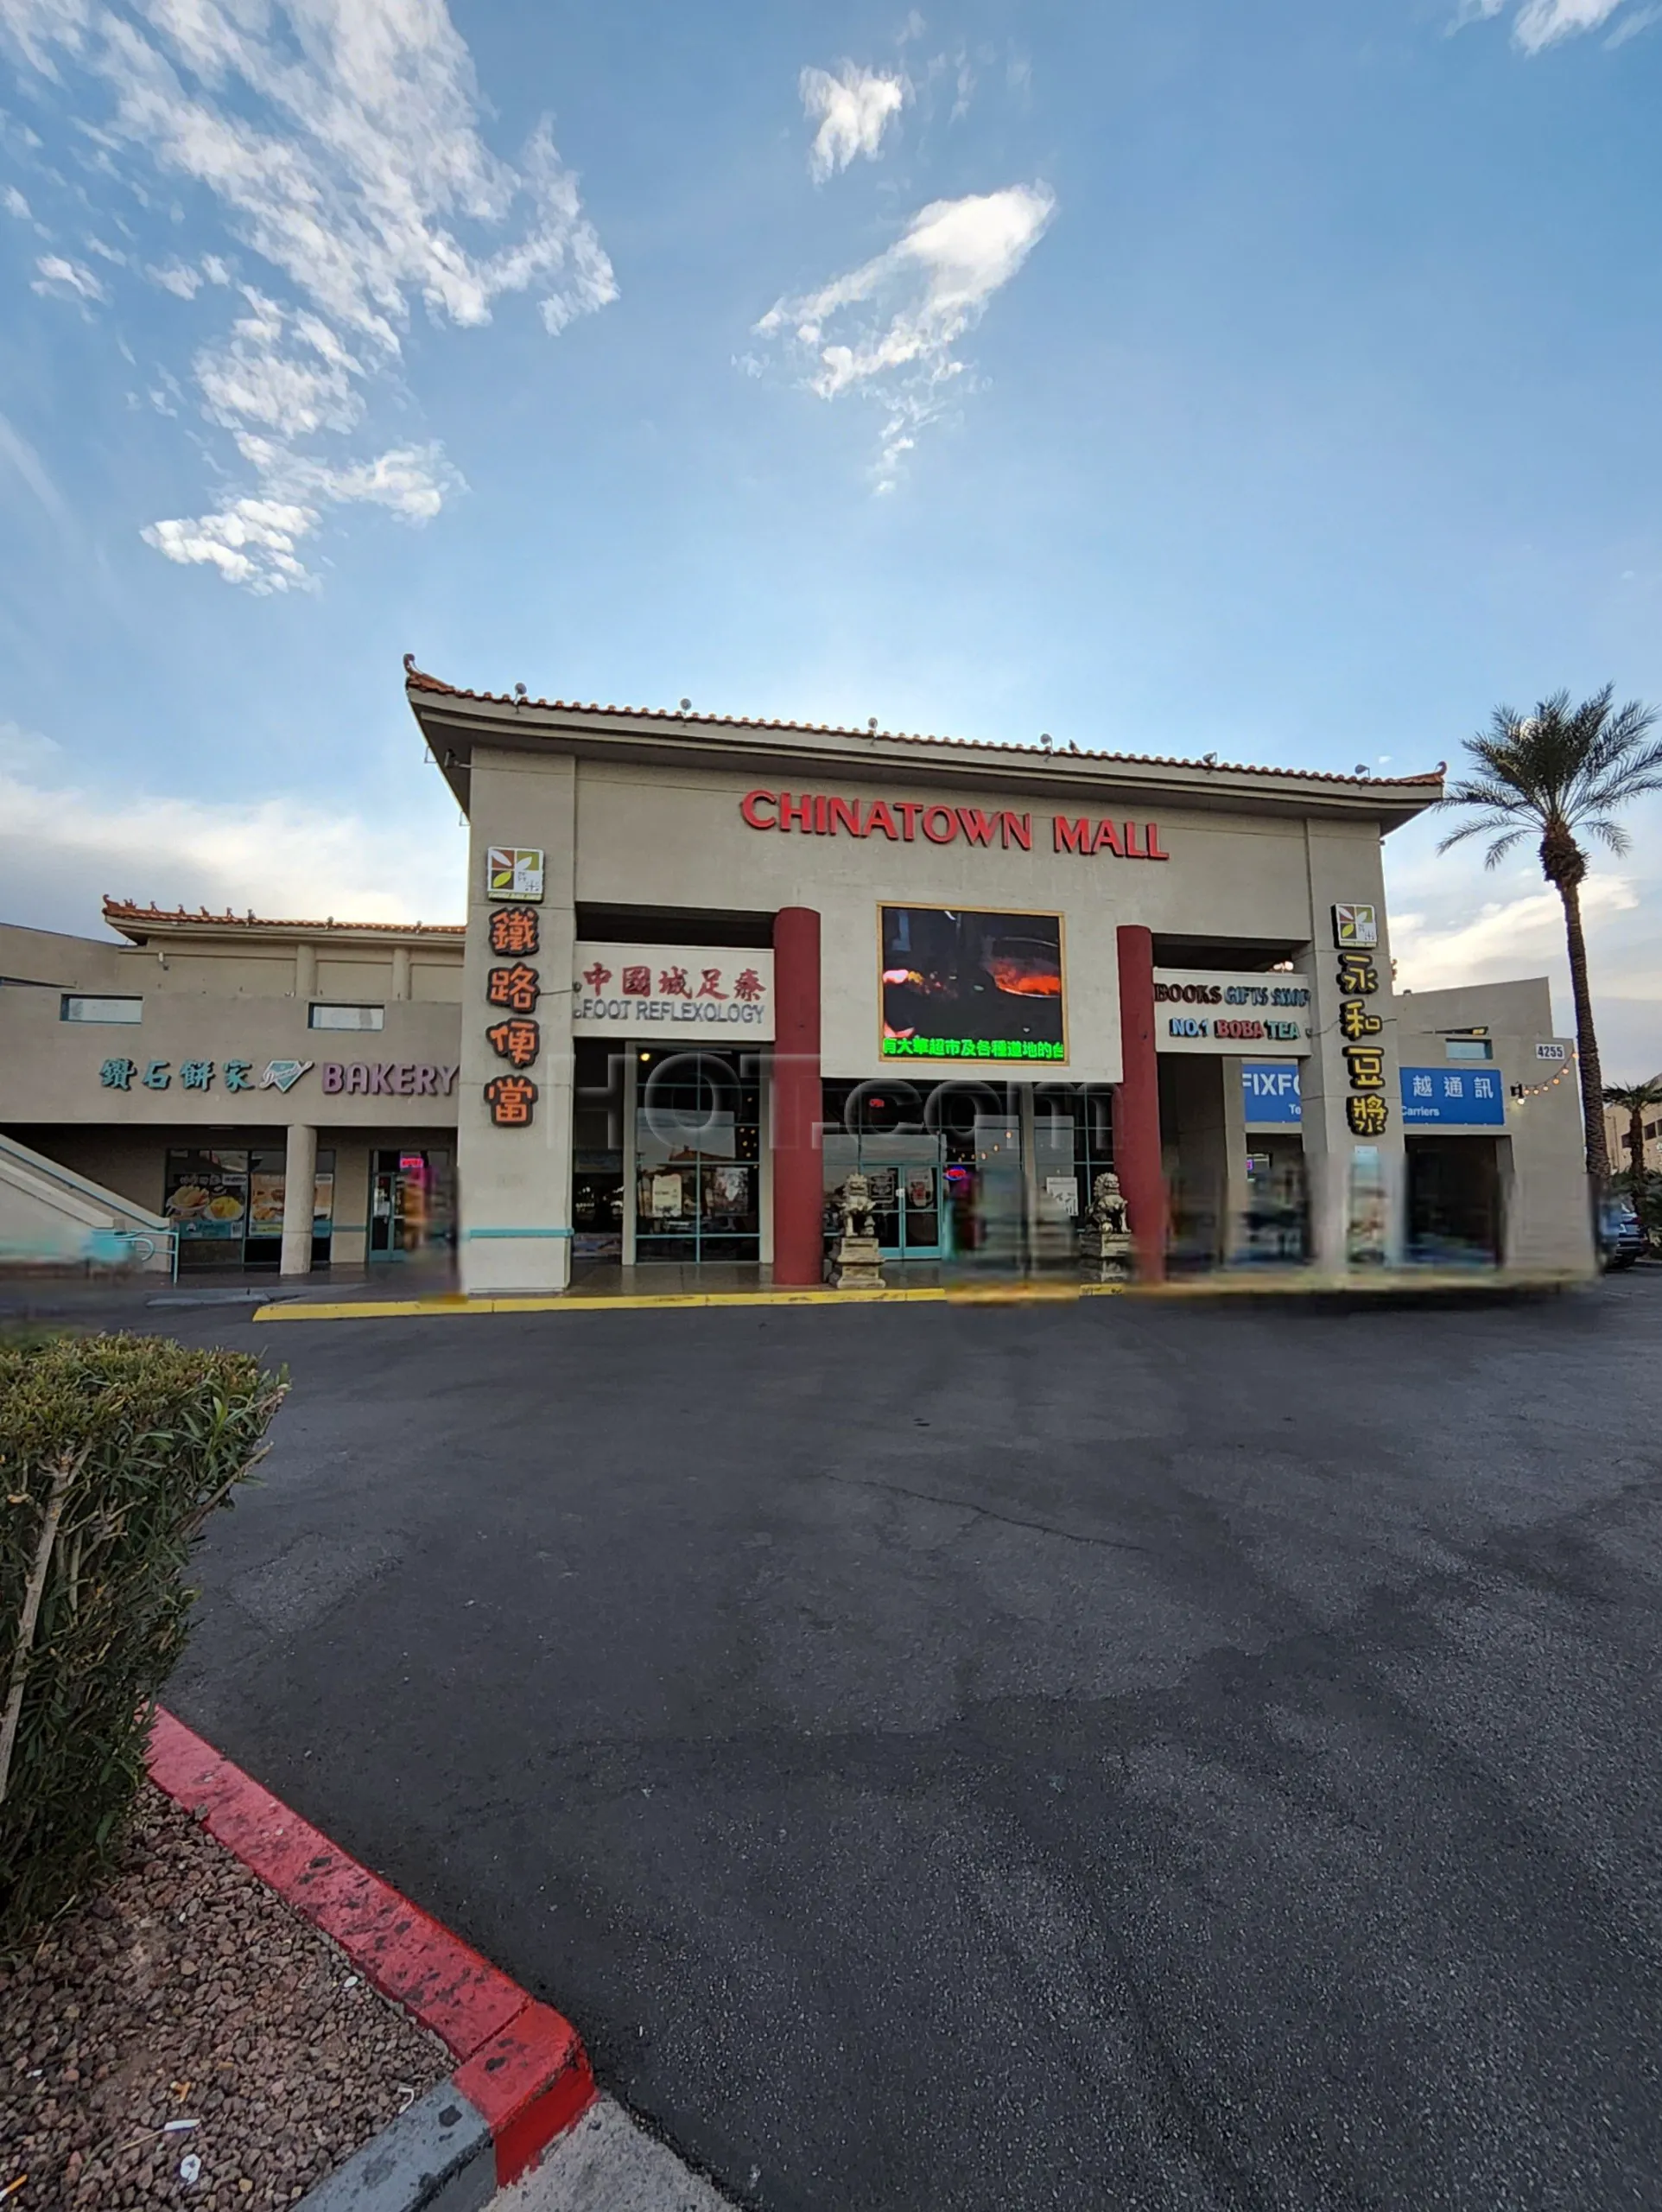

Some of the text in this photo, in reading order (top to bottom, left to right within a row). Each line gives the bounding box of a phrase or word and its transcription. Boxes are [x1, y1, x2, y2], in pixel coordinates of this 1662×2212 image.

[740, 789, 1170, 861] CHINATOWN MALL
[1154, 983, 1222, 1005] BOOKS
[1224, 986, 1269, 1006] GIFTS
[485, 909, 539, 1125] 鐵路便當
[583, 999, 764, 1023] FOOT REFLEXOLOGY
[1169, 1017, 1301, 1041] NO.1 BOBA TEA
[1338, 954, 1387, 1135] 永和豆漿
[1537, 1046, 1564, 1058] 4255
[100, 1058, 255, 1093] 鑽石餅家
[322, 1063, 460, 1096] BAKERY
[1412, 1074, 1494, 1099] 越通訊
[1401, 1105, 1441, 1116] Carriers
